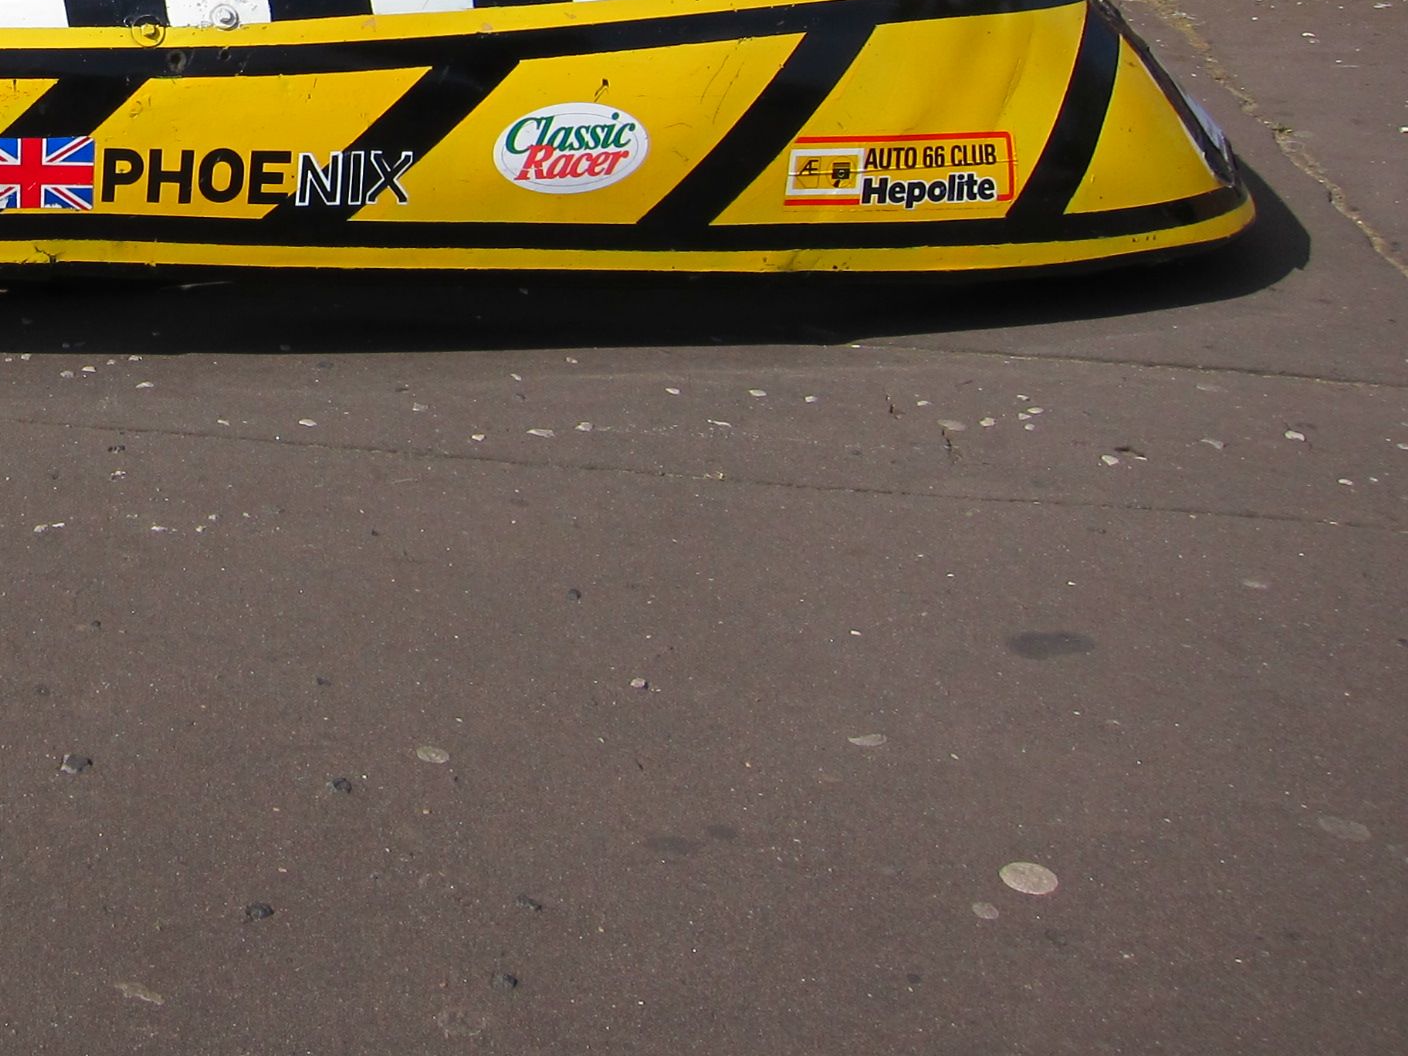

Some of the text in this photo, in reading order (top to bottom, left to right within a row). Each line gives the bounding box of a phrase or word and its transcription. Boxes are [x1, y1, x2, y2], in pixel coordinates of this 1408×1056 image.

[505, 112, 636, 154] Classic
[514, 144, 629, 180] Racer
[864, 144, 997, 170] AUTO 66 CLUB
[101, 147, 413, 207] PHOENIX
[860, 172, 996, 210] Hepolite
